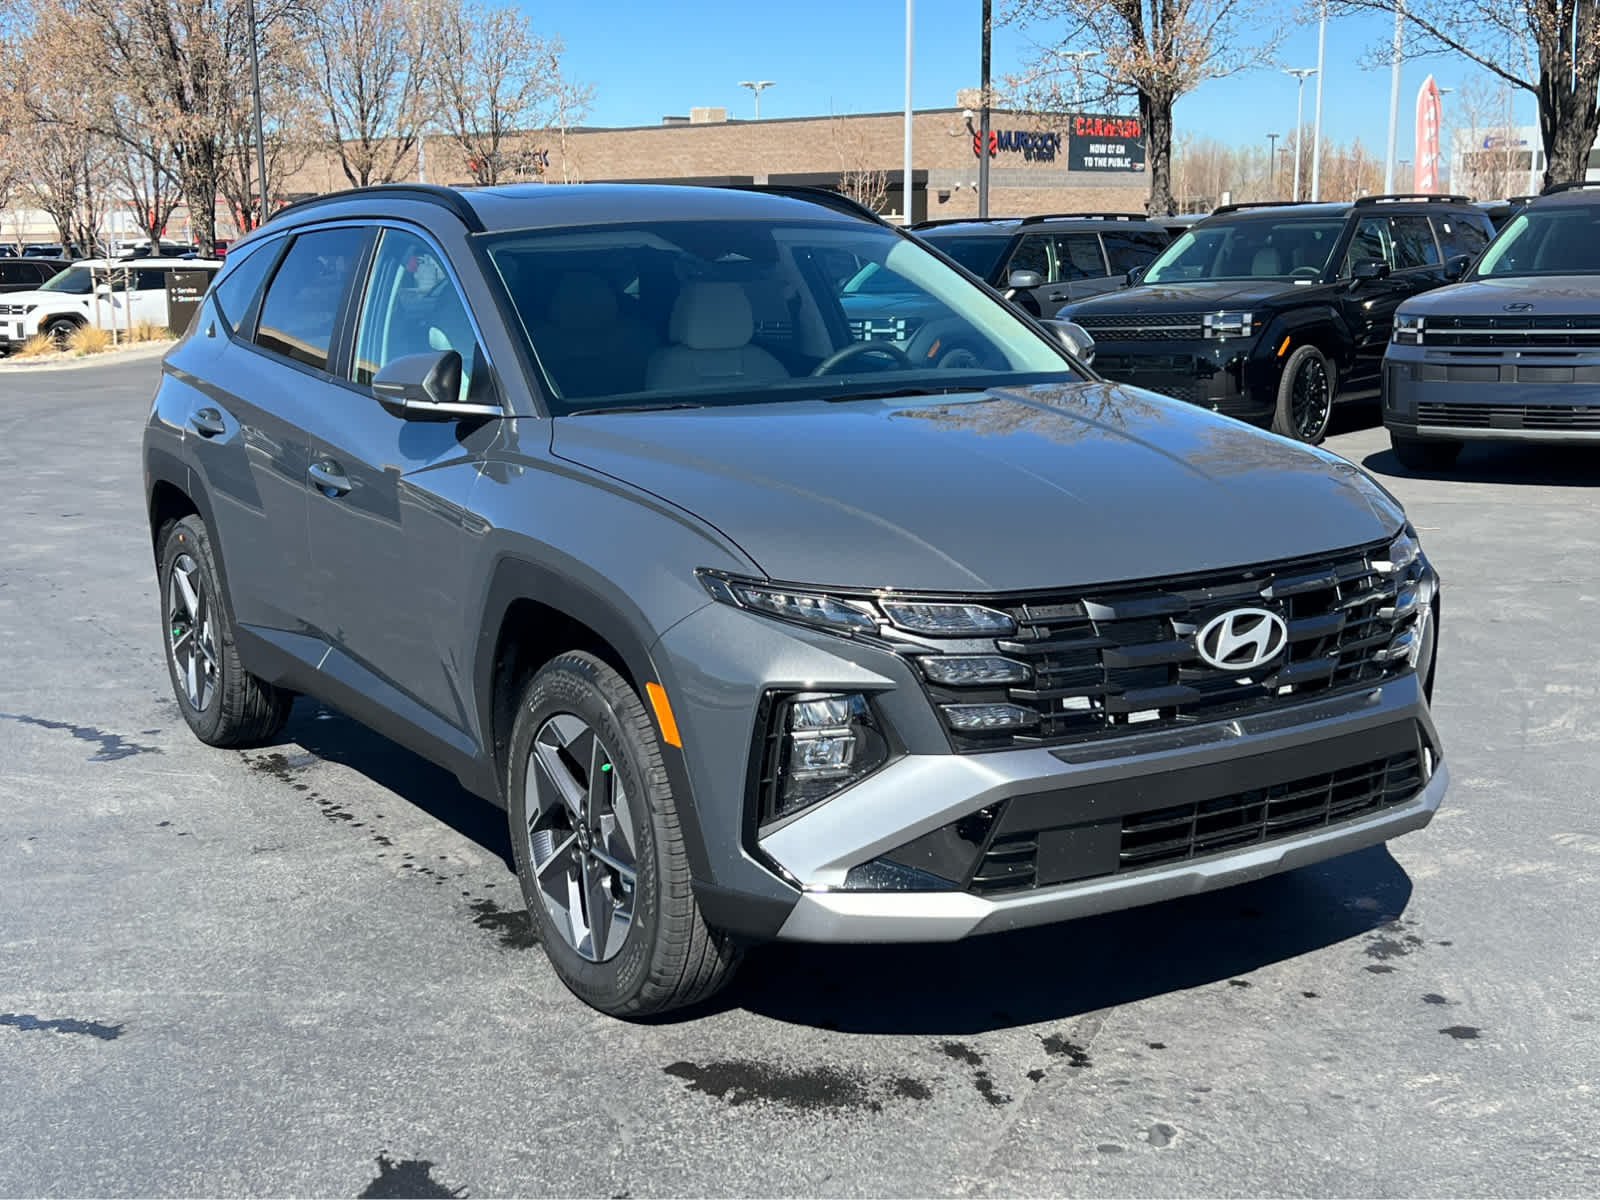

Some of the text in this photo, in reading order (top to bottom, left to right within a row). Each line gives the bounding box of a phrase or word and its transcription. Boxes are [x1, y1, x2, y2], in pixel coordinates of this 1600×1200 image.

[1089, 144, 1107, 154] NOW
[1084, 157, 1093, 167] TO
[1094, 157, 1107, 168] THE
[1108, 157, 1132, 168] PUBLIC
